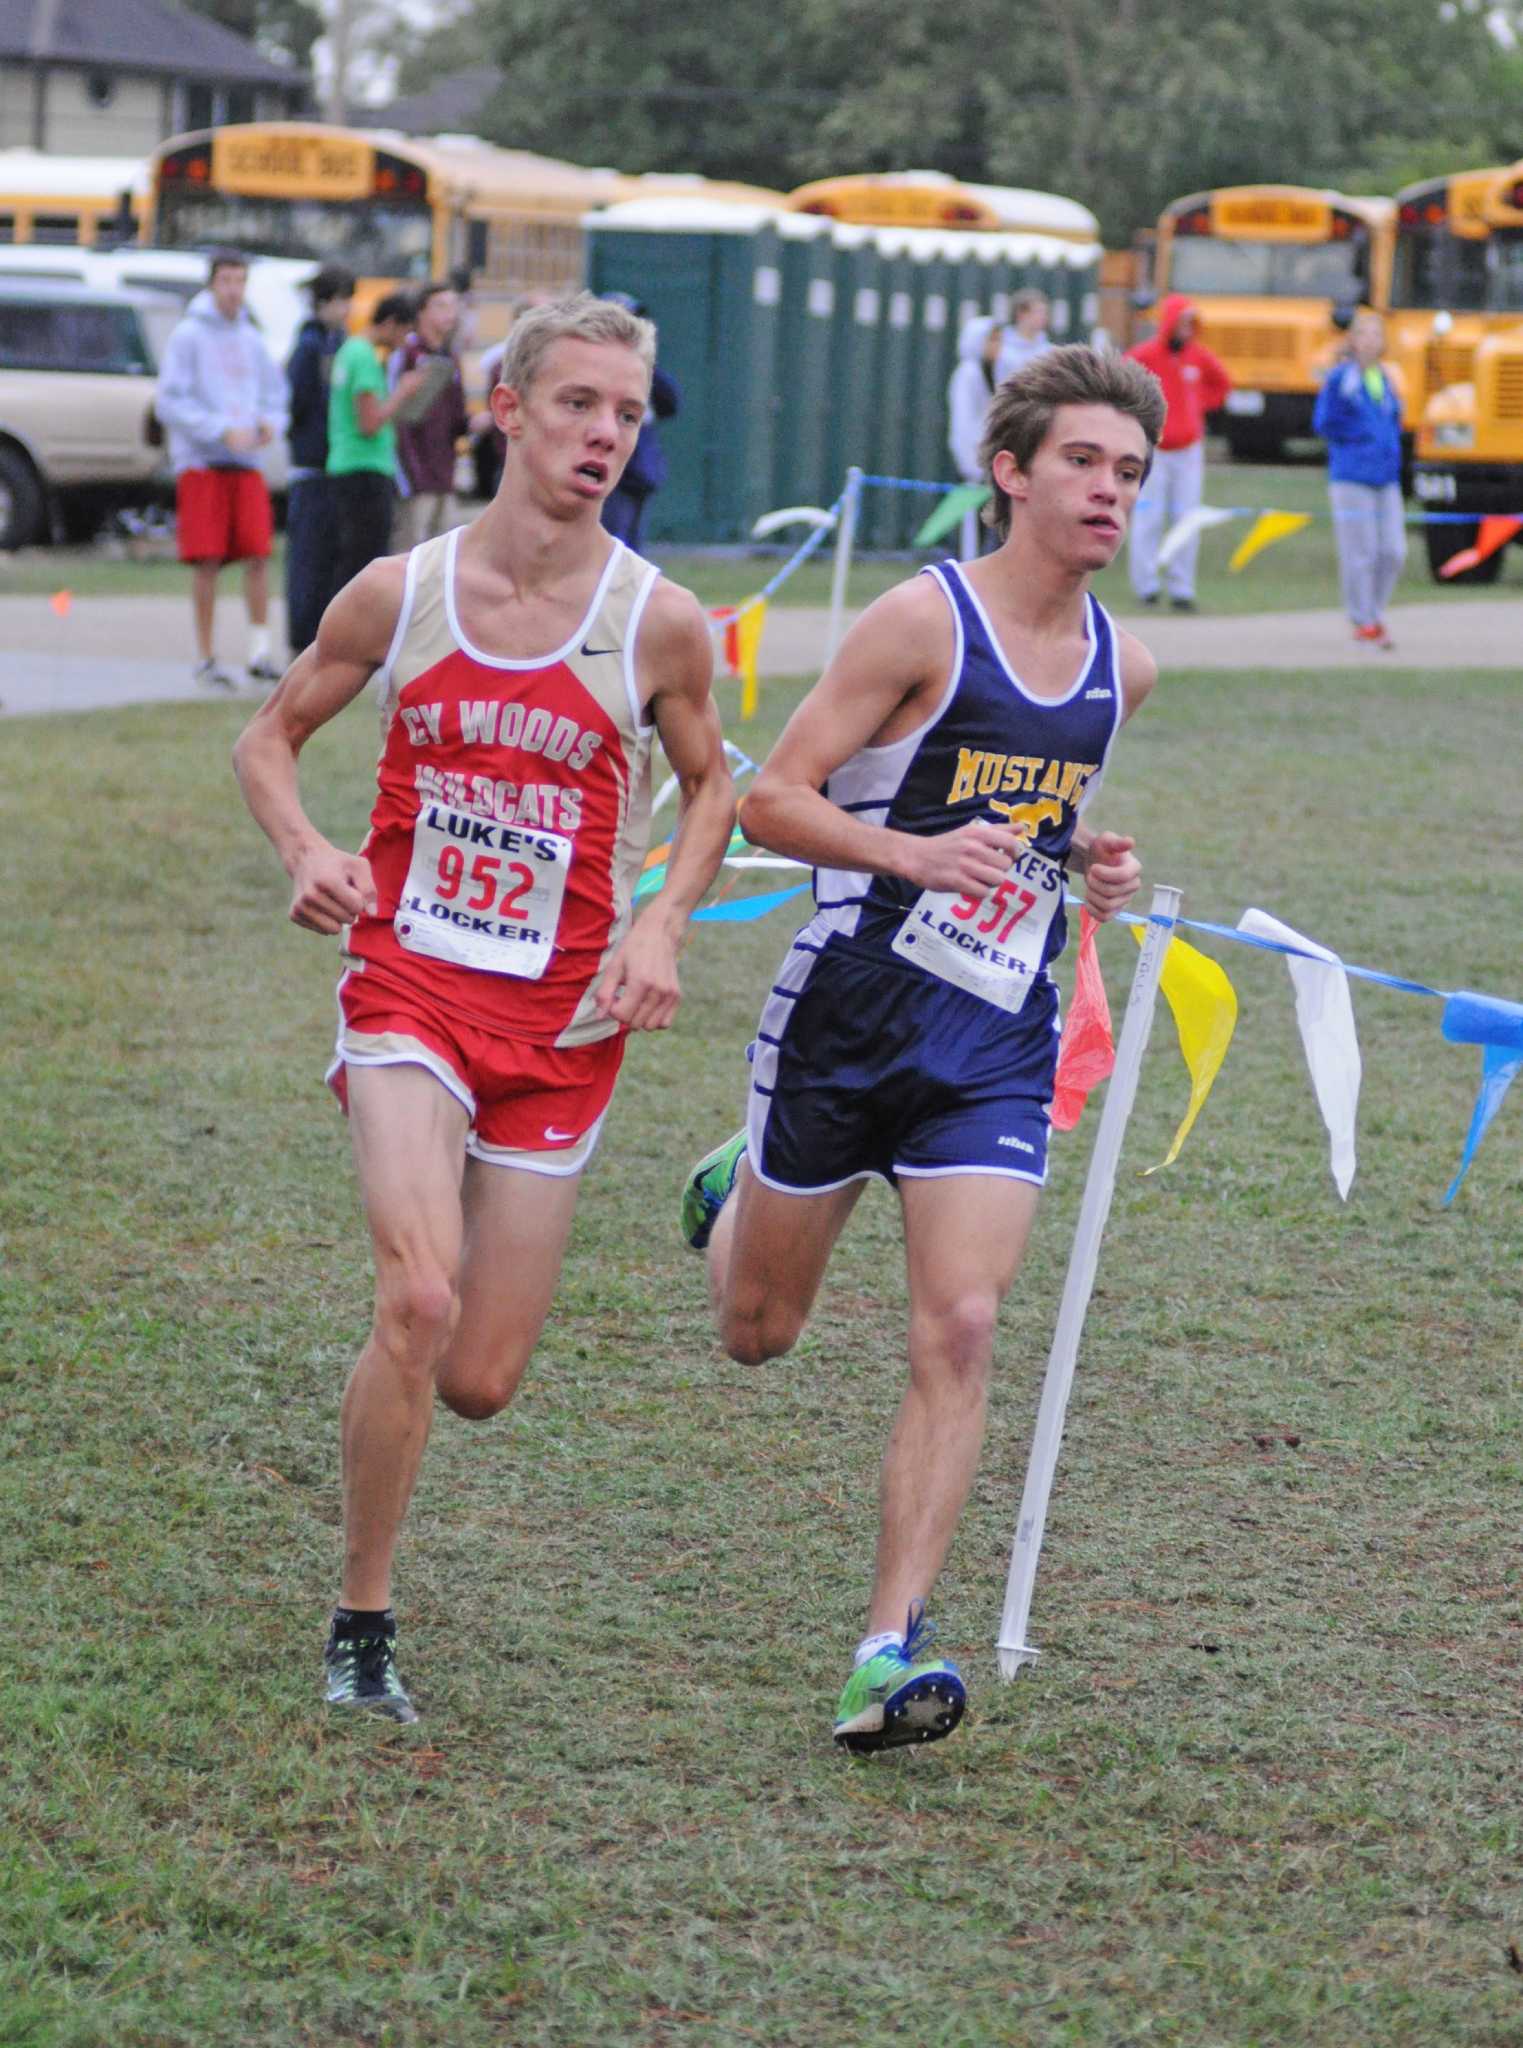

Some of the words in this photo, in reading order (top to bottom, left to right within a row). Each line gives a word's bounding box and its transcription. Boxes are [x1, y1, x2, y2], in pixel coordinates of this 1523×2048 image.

[400, 703, 443, 746] CY
[459, 701, 602, 770] WOODS
[414, 763, 583, 829] WILDCATS
[427, 807, 557, 862] LUKE'S
[434, 845, 534, 921] 952
[409, 896, 542, 944] LOCKER
[920, 909, 1028, 975] LOCKER
